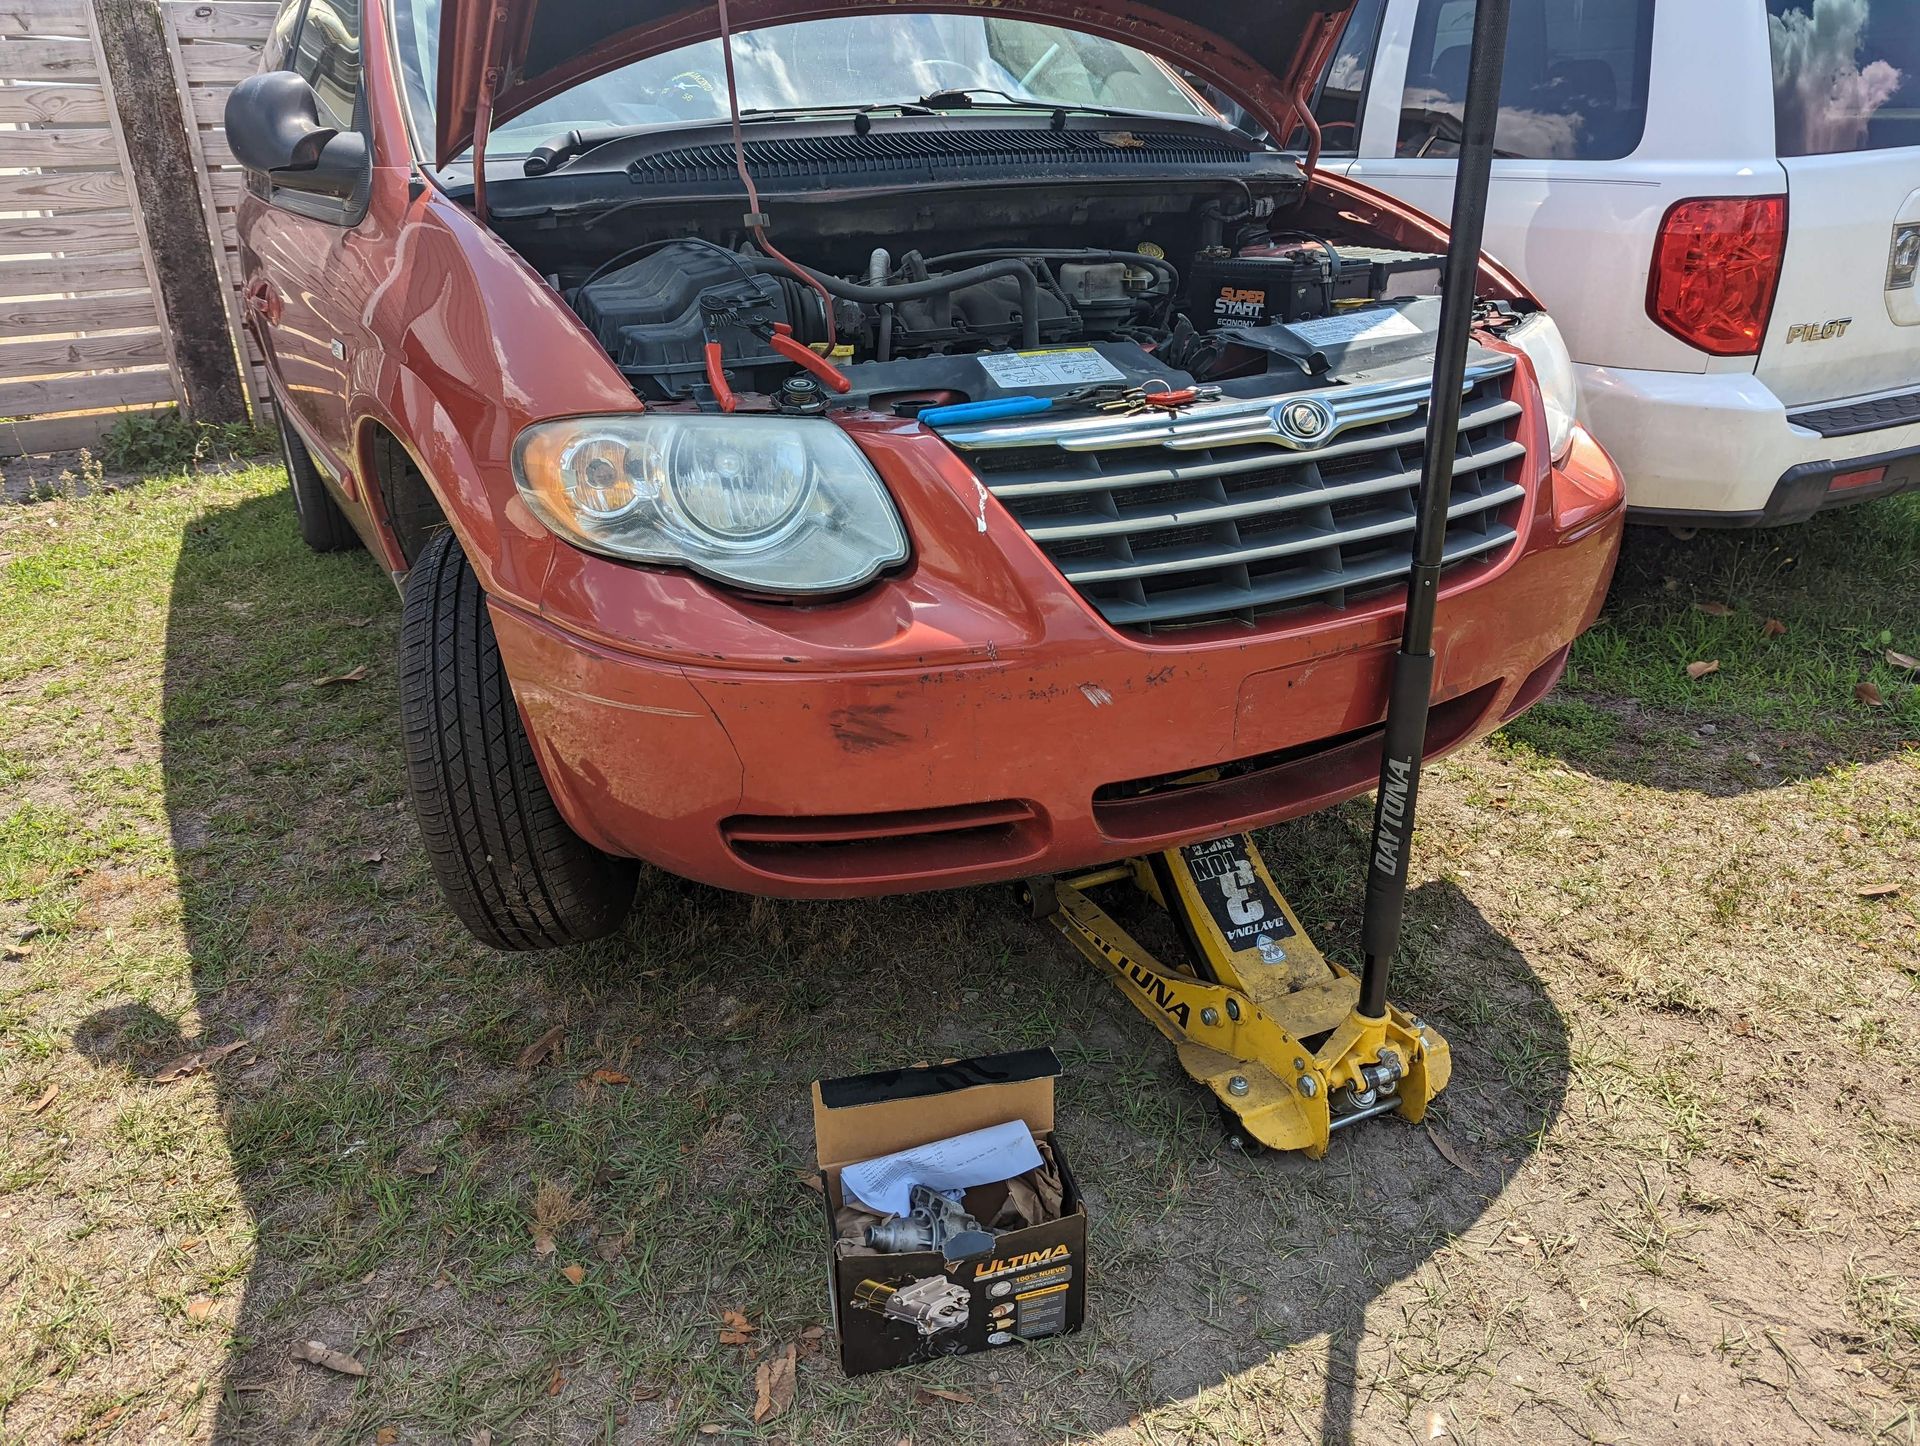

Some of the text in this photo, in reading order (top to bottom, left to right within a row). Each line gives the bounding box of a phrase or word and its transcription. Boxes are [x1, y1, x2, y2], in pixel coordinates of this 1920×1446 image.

[1213, 298, 1265, 316] START
[1220, 287, 1265, 304] SUPER
[1216, 318, 1256, 328] ECONOMY
[1786, 317, 1852, 344] PILOT
[1375, 757, 1412, 876] DAYTONA
[1191, 851, 1240, 882] TON
[1219, 859, 1265, 926] 3
[1226, 917, 1284, 940] DAYTONA
[975, 1244, 1070, 1277] ULTIMA
[1015, 1273, 1037, 1283] 100%
[1039, 1266, 1067, 1277] NUEVO
